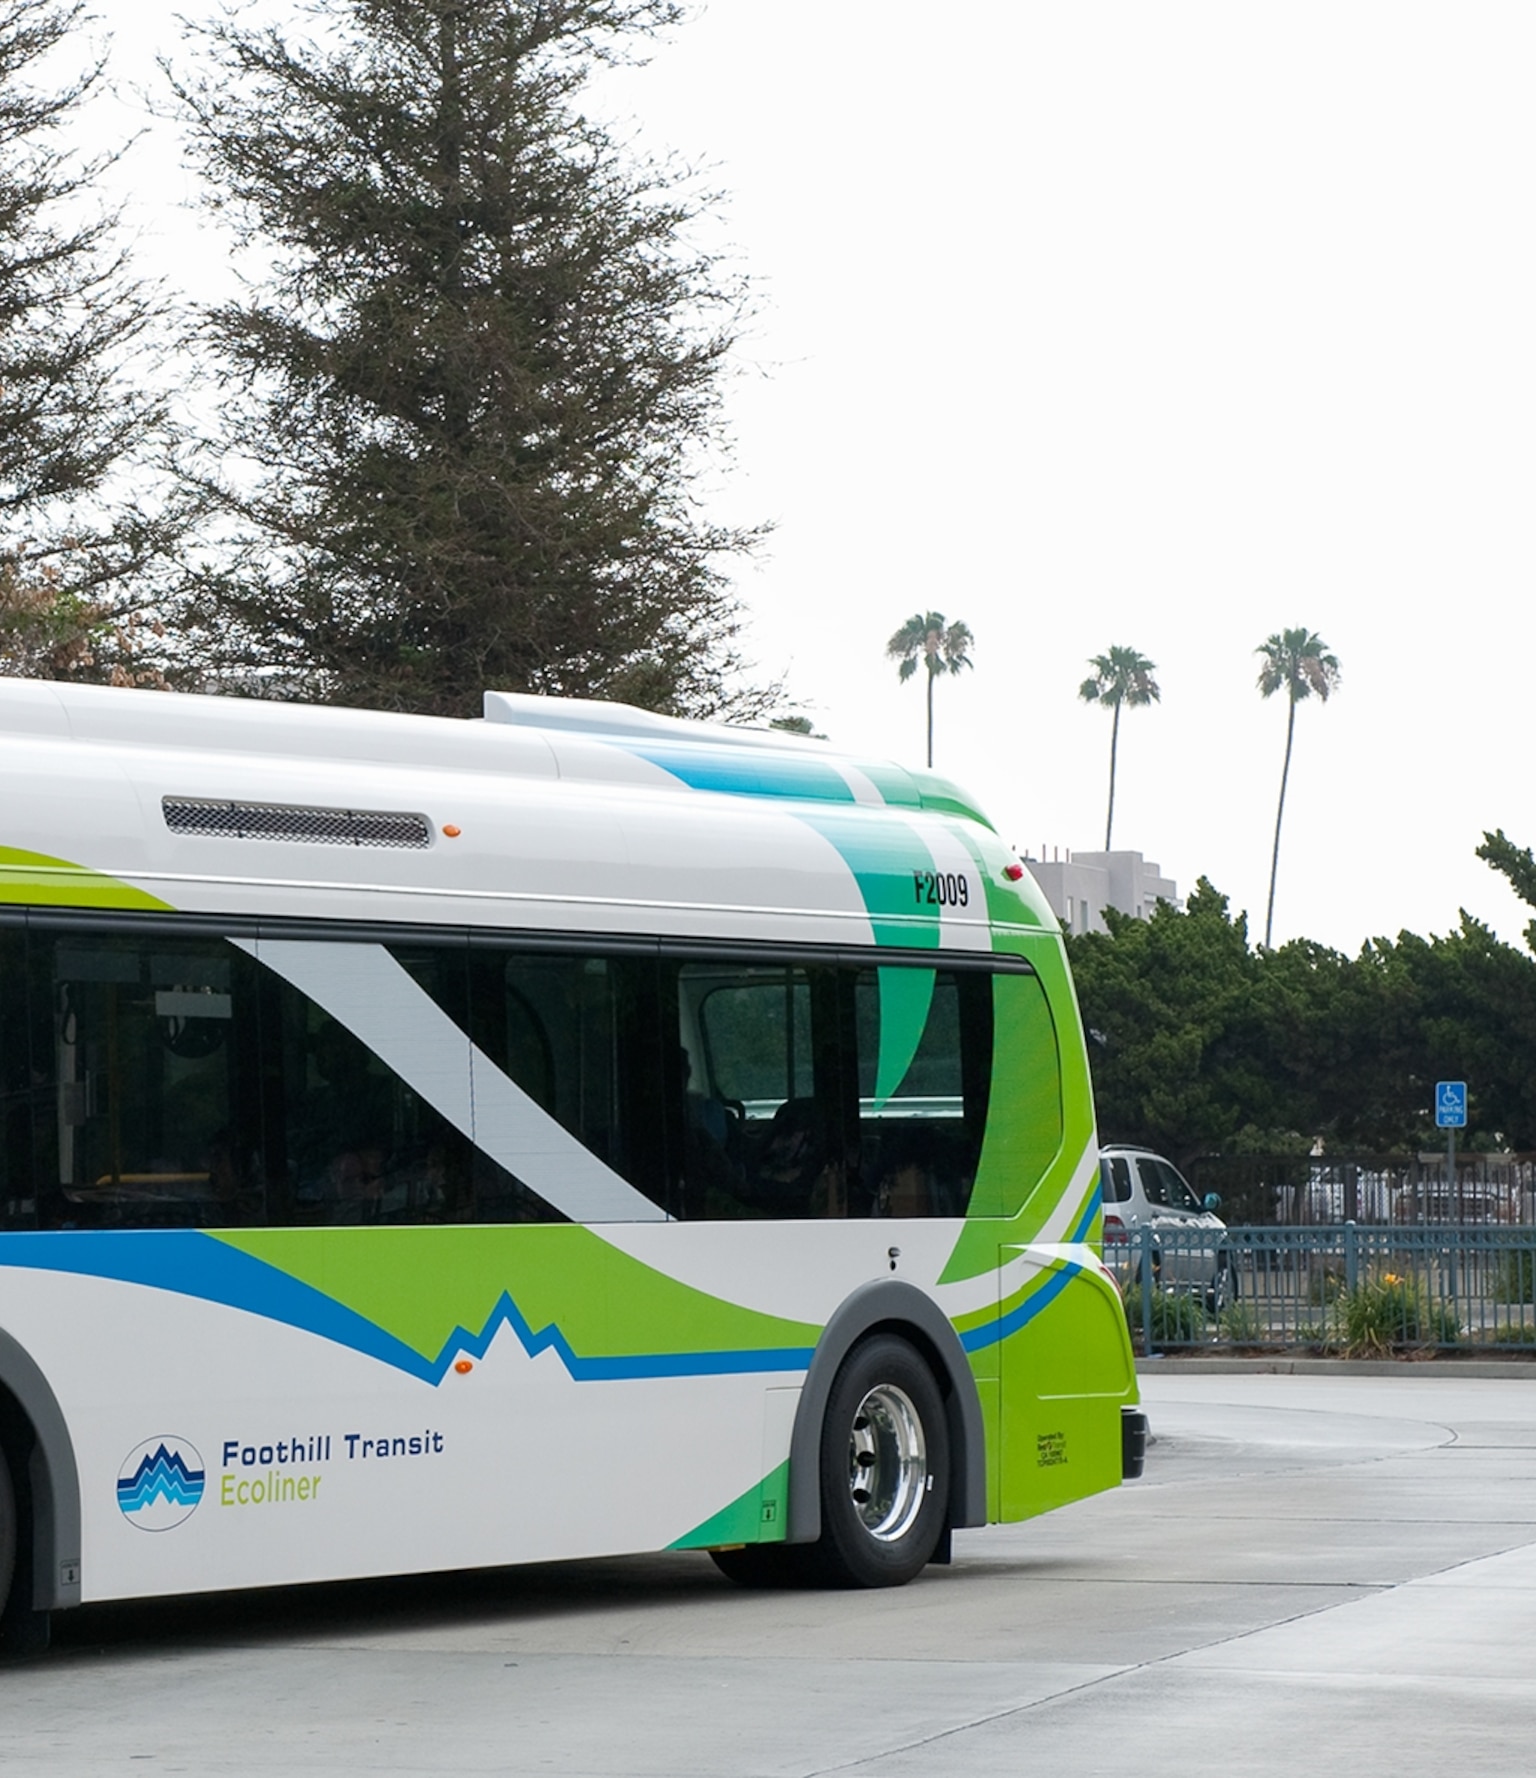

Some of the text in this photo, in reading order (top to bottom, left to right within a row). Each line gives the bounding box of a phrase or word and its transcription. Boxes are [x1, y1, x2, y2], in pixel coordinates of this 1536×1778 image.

[913, 870, 969, 907] F2009
[222, 1429, 444, 1467] Foothill Transit
[220, 1470, 322, 1506] Ecoliner
